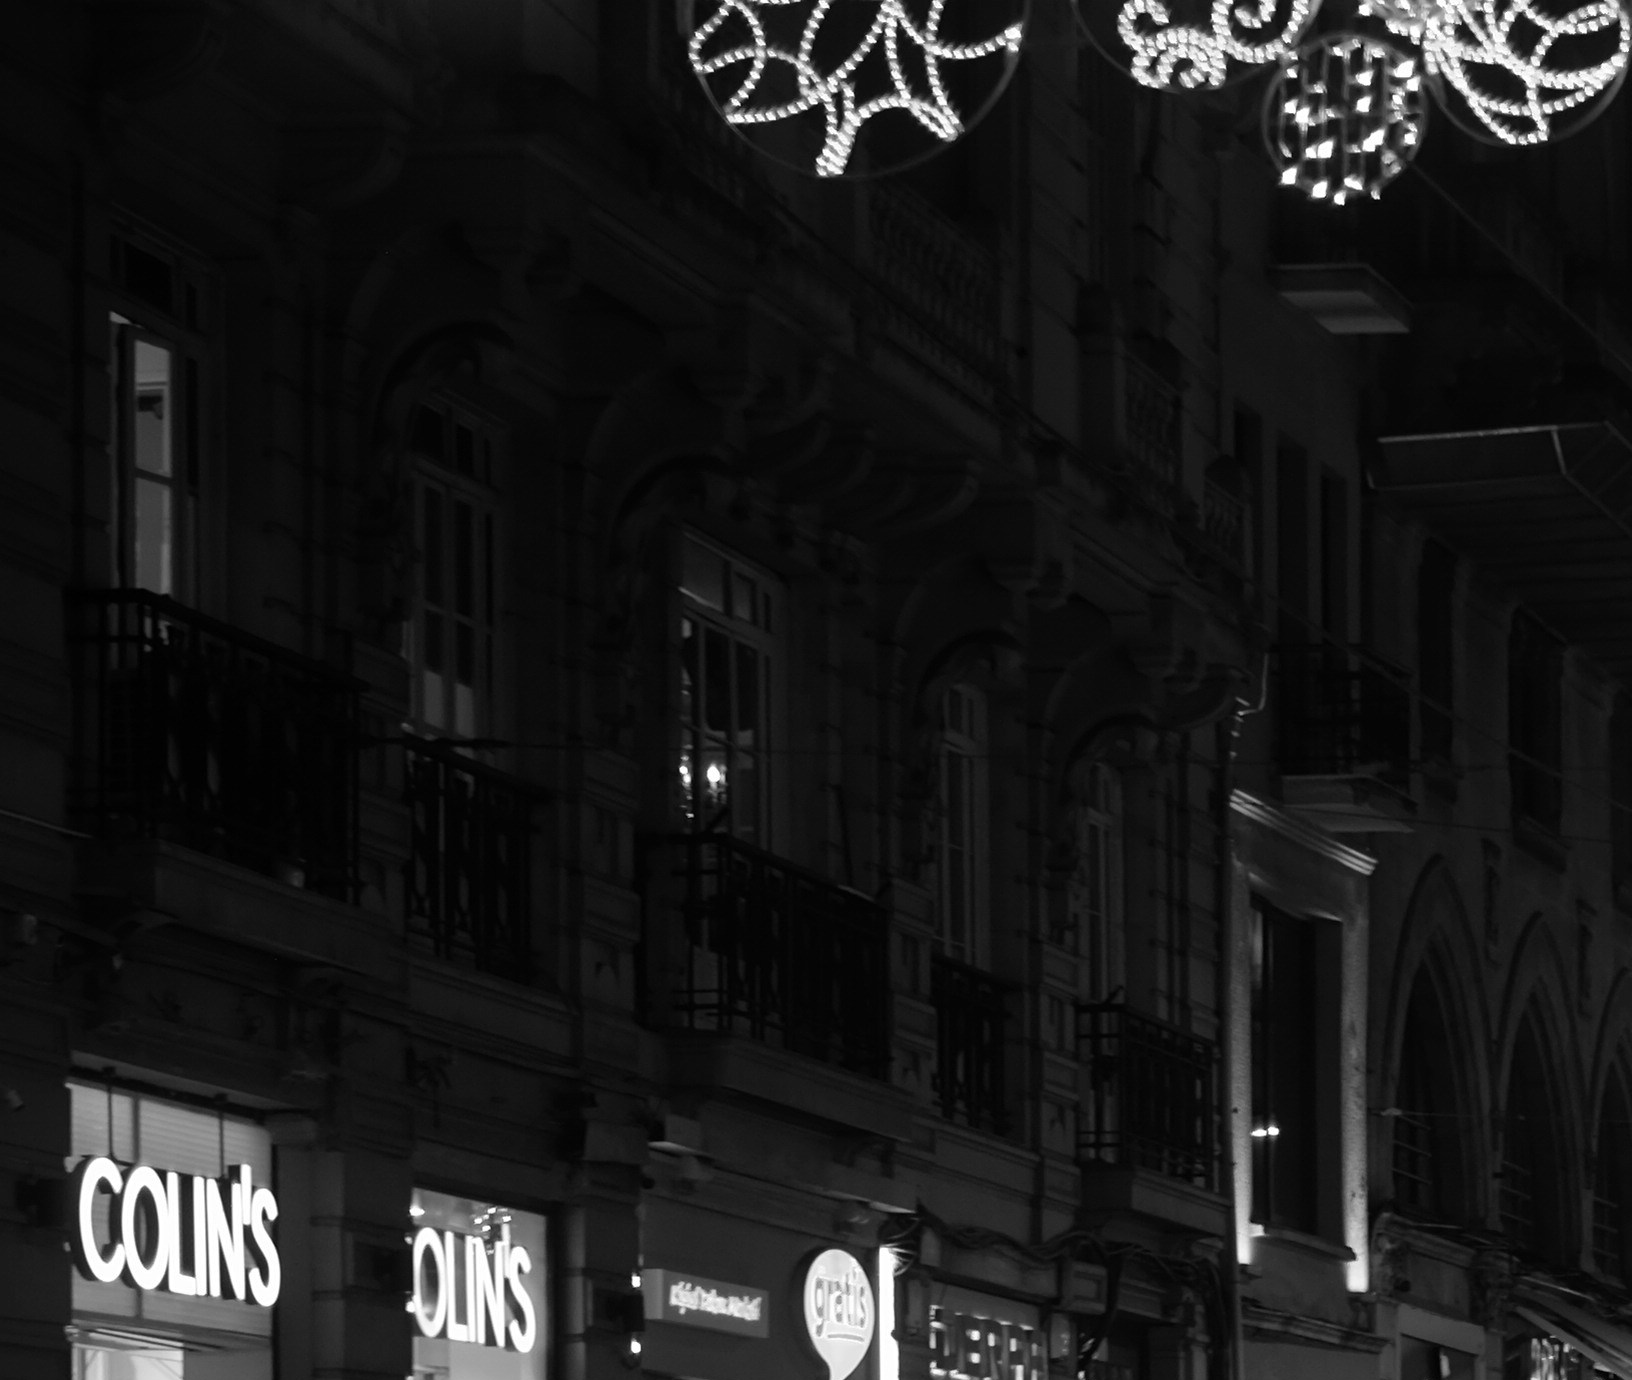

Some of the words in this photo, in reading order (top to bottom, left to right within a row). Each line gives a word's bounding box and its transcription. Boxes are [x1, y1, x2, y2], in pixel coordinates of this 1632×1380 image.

[79, 1156, 281, 1308] COLIN'S
[413, 1222, 537, 1354] OLIN'S
[815, 1267, 866, 1338] gratis
